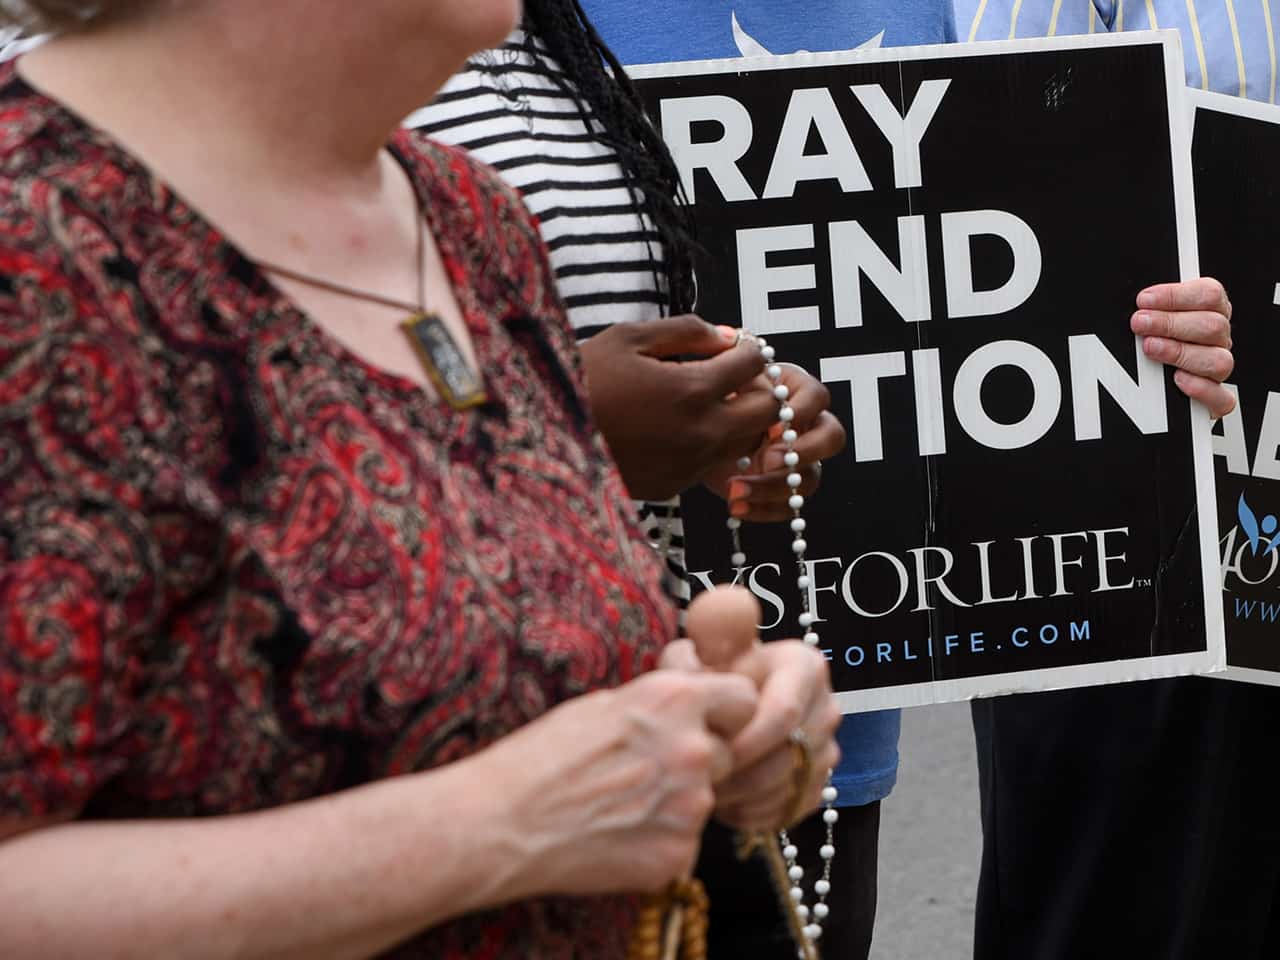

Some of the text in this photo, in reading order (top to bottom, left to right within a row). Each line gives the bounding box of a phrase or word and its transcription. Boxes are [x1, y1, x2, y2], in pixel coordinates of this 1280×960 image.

[659, 78, 952, 204] RAY
[735, 209, 1042, 336] END
[819, 333, 1169, 464] TION
[817, 619, 1093, 669] FORLIFE.COM
